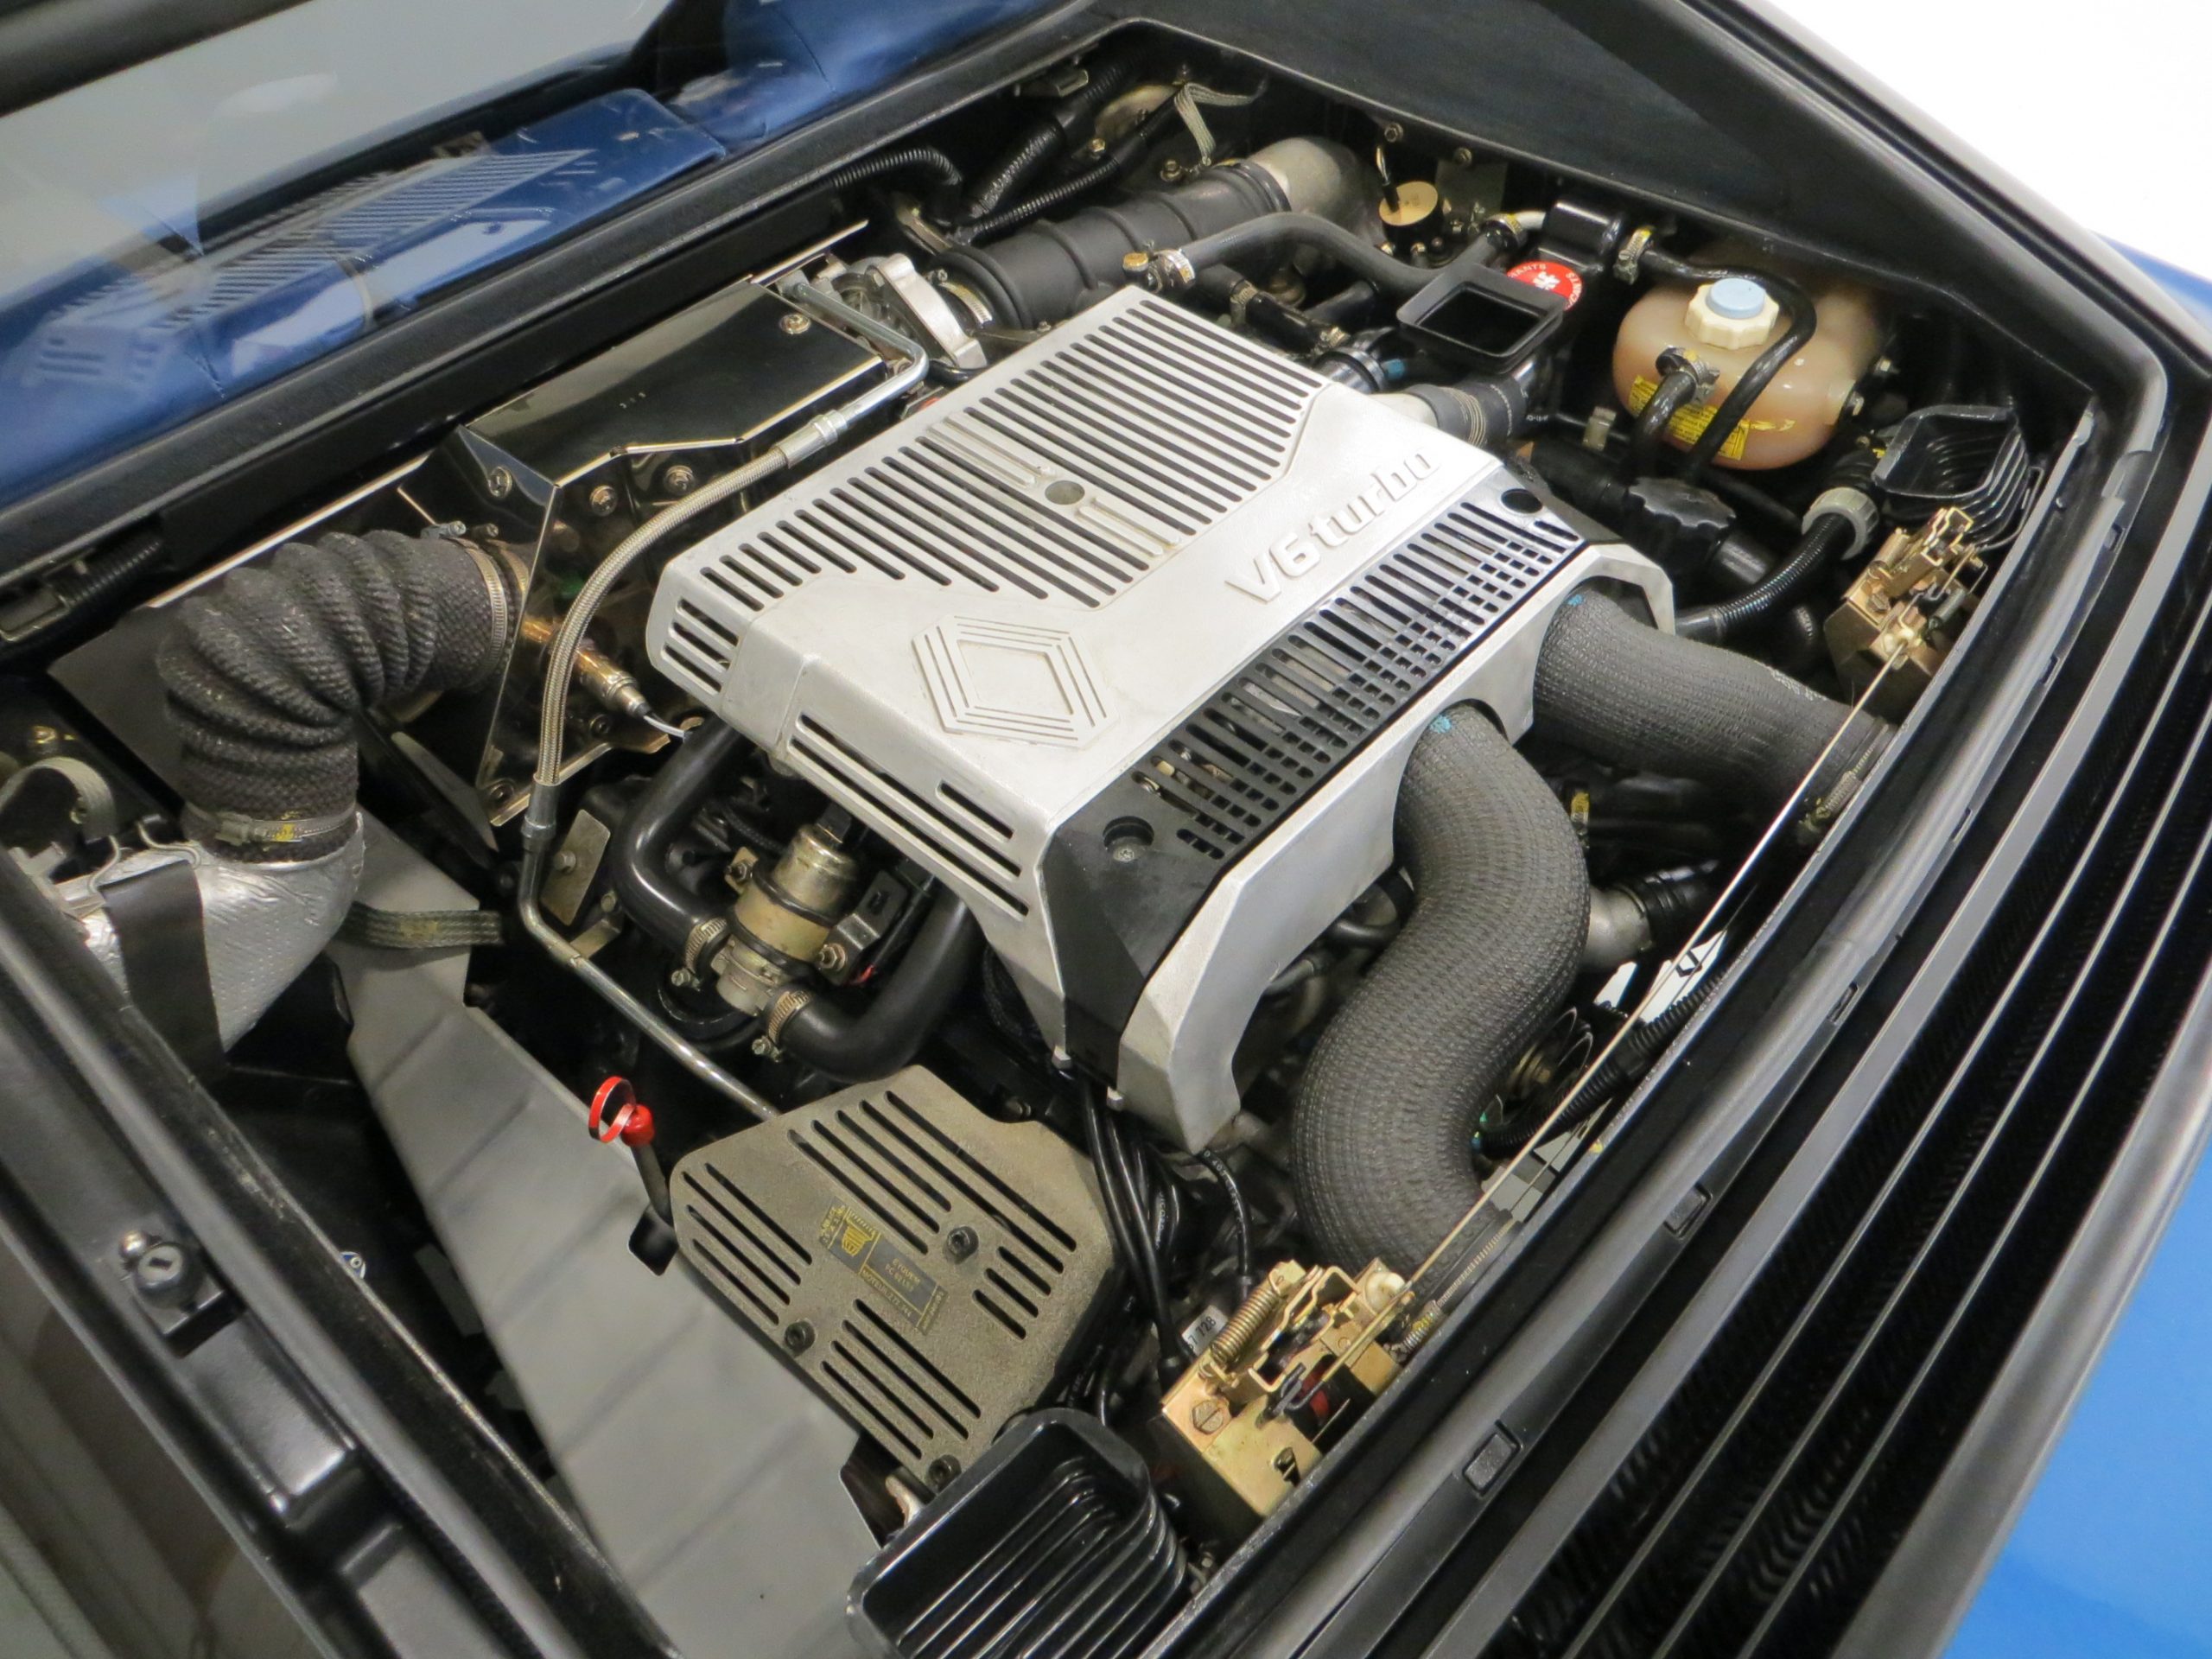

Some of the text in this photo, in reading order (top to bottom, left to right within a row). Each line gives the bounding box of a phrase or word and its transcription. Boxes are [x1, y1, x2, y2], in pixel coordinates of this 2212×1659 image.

[1224, 447, 1441, 604] V6 turbo
[1195, 1316, 1217, 1338] 728
